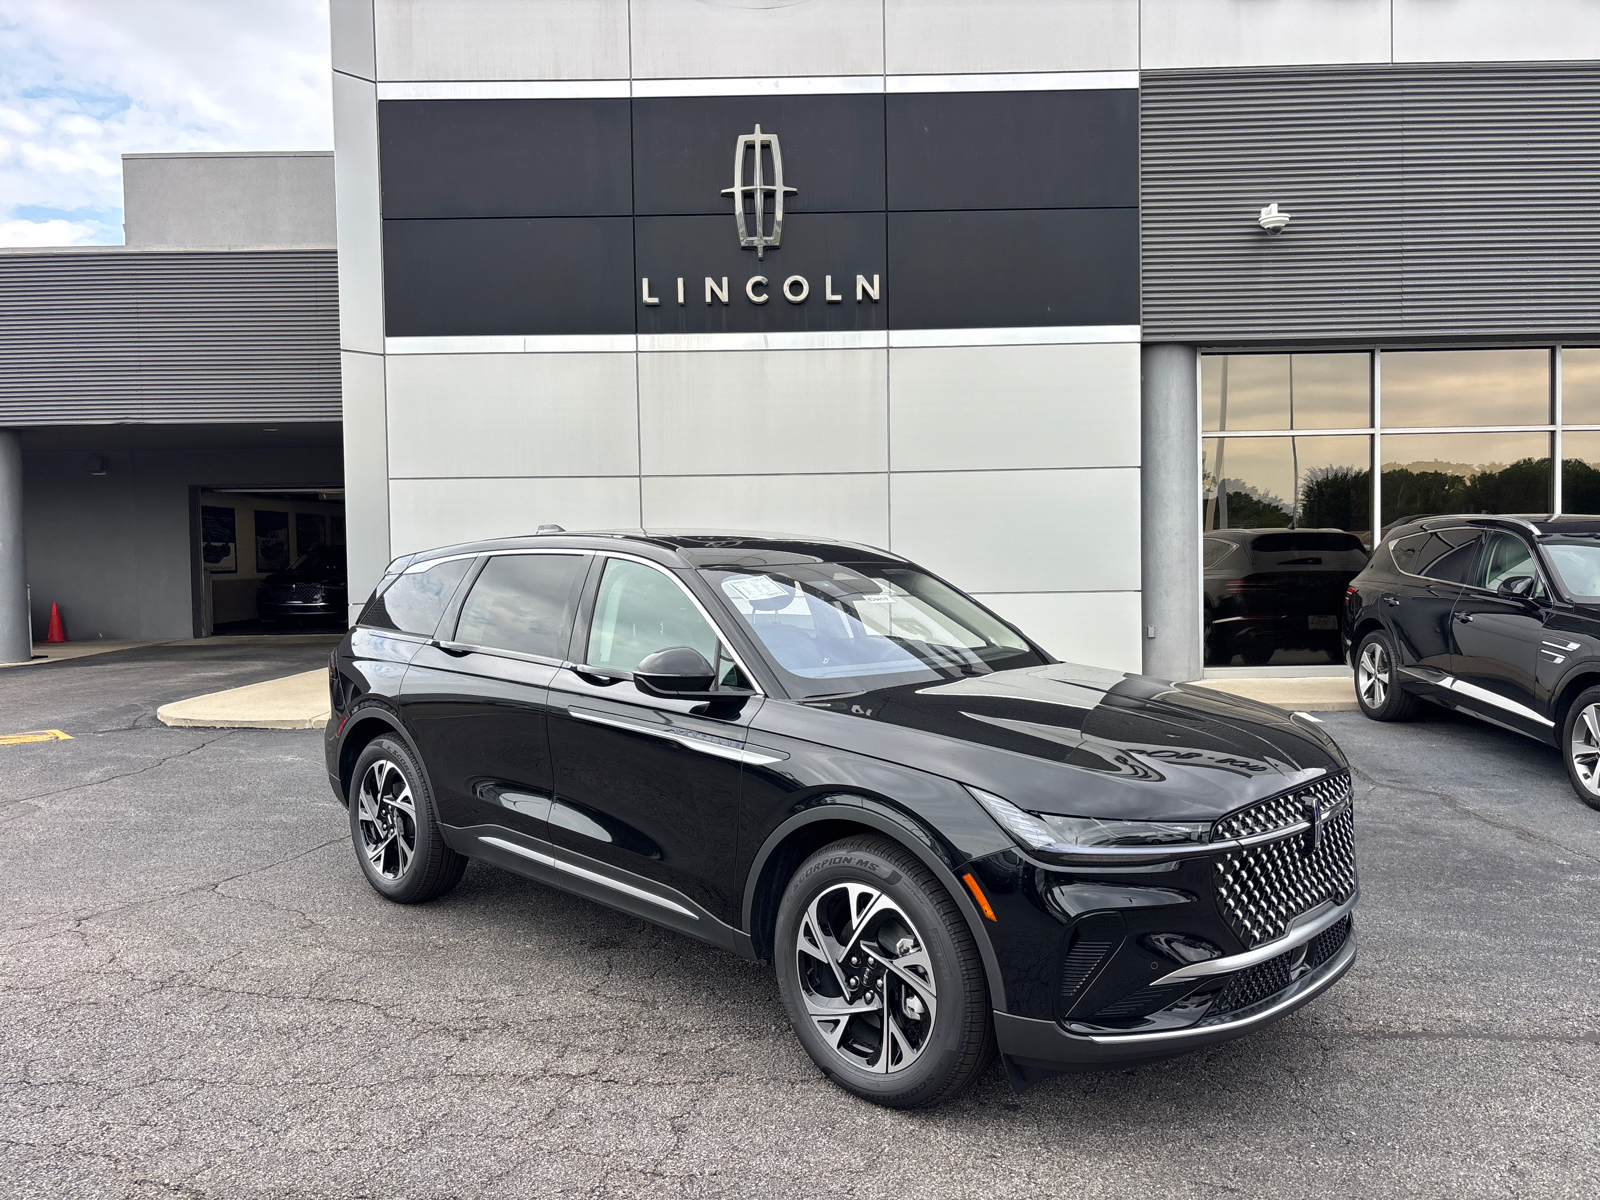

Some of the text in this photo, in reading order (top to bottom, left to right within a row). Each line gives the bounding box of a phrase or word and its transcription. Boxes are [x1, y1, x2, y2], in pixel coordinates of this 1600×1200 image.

[642, 274, 880, 305] LINCOLN
[792, 855, 880, 892] SCORPION MS
